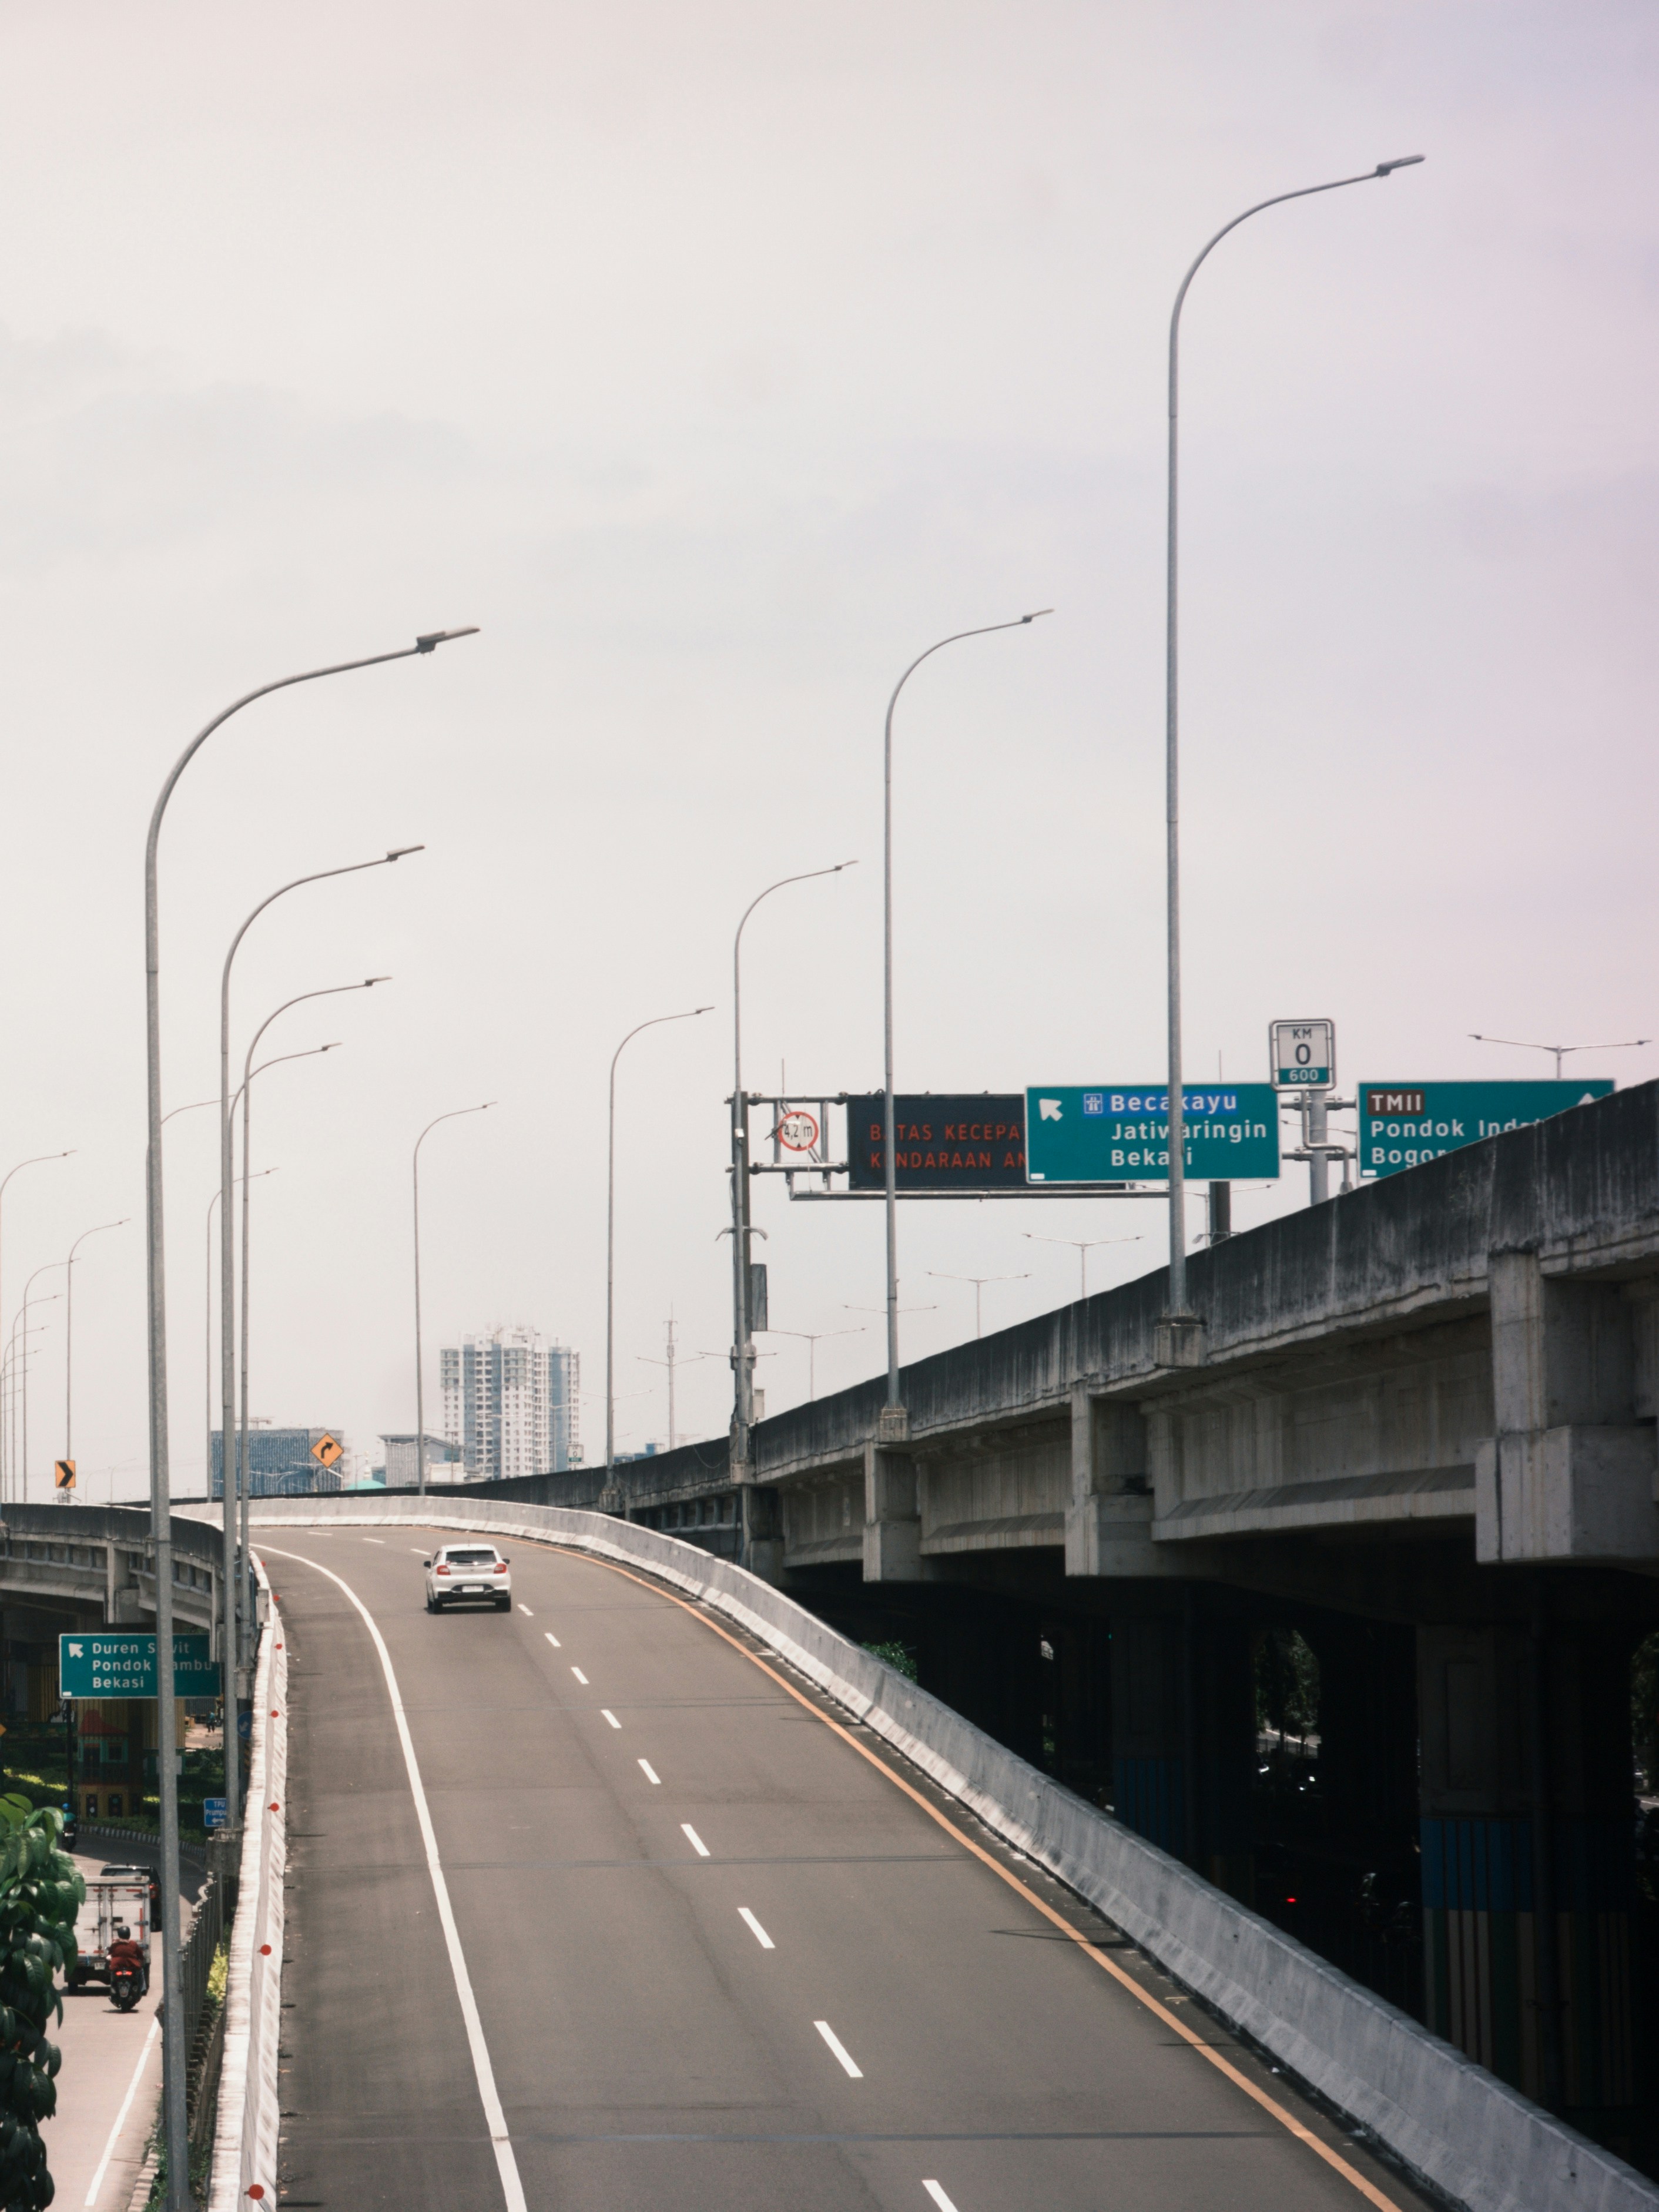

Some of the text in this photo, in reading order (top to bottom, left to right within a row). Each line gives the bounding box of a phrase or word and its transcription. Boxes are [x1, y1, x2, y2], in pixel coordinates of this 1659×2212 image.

[1293, 1028, 1312, 1039] KM
[1295, 1043, 1311, 1065] 0
[1289, 1069, 1319, 1081] 600
[1371, 1094, 1421, 1111] TMII
[870, 1123, 1024, 1141] BTAS KECEPA
[1371, 1118, 1540, 1137] Pondok Ind
[870, 1152, 991, 1168] KNDARAAN
[1111, 1147, 1192, 1166] Bekai
[92, 1642, 190, 1654] Duren Sit
[92, 1659, 151, 1671] Pondok
[93, 1675, 145, 1688] Bekasi
